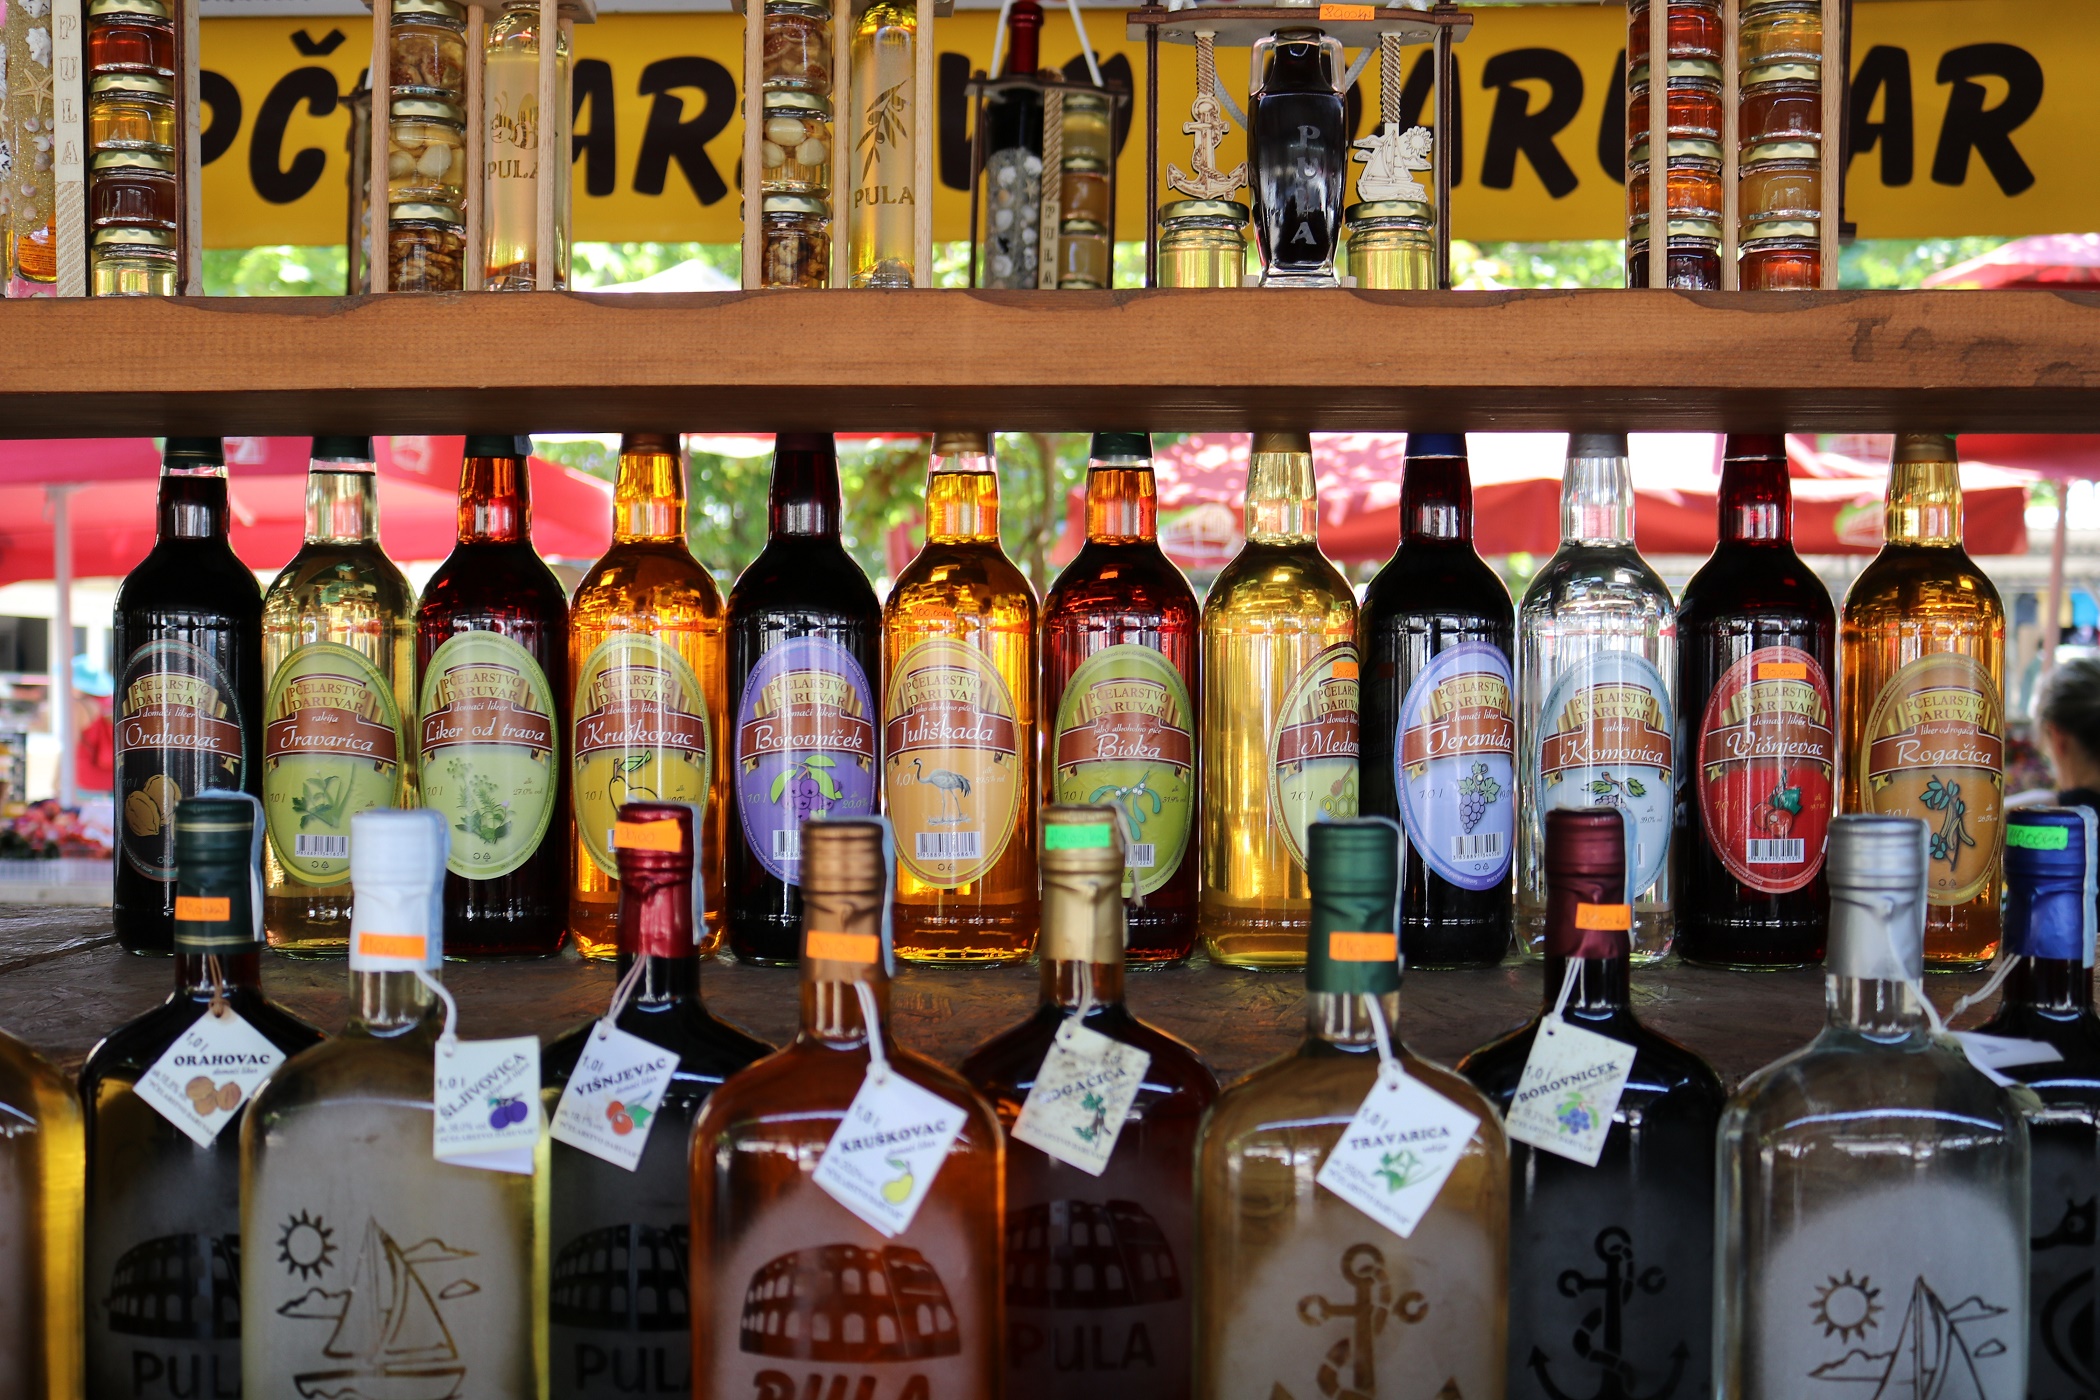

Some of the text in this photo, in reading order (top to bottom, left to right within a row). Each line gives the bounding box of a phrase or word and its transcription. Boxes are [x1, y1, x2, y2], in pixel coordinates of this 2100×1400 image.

[58, 15, 81, 165] PULA
[853, 184, 916, 210] PULA
[1290, 125, 1321, 245] PULA
[133, 679, 210, 696] PČELARSTVO
[289, 683, 368, 700] PČELARSTVO
[443, 672, 521, 689] PČELARSTVO
[906, 675, 983, 692] PČELARSTVO
[1437, 681, 1506, 700] PČELARSTVO
[292, 696, 364, 713] DARUVAR
[446, 686, 518, 702] DARUVAR
[1088, 687, 1169, 703] PČELARSTVO
[1442, 695, 1504, 712] DARUVAR
[1906, 695, 1986, 711] PČELARSTVO
[312, 711, 339, 723] rakija
[1092, 701, 1165, 717] DARUVAR
[1578, 706, 1650, 721] DARUVAR
[1743, 701, 1814, 715] DARUVAR
[1910, 709, 1983, 724] DARUVAR
[126, 722, 221, 748] Orahovac
[280, 725, 374, 751] Travarica
[426, 716, 545, 743] Liker od trava
[583, 719, 694, 748] Kruškovac
[754, 725, 863, 750] Borovniček
[901, 714, 993, 749] Juliškada
[1426, 724, 1511, 754] Teranida
[1096, 732, 1161, 758] Biska
[1560, 738, 1664, 765] Komovica
[1726, 731, 1824, 757] Višnjevac
[1895, 739, 1992, 766] Rogačica
[174, 1054, 270, 1067] ORAHOVAC
[439, 1052, 527, 1120] ŠLJIVOVICA
[574, 1057, 668, 1097] VIŠNJEVAC
[1518, 1060, 1619, 1104] BOROVNIČEK
[840, 1120, 947, 1154] KRUŠKOVAC
[1349, 1126, 1451, 1150] TRAVARICA
[1007, 1320, 1157, 1372] PULA
[131, 1349, 241, 1400] PUL
[574, 1342, 692, 1394] PUL
